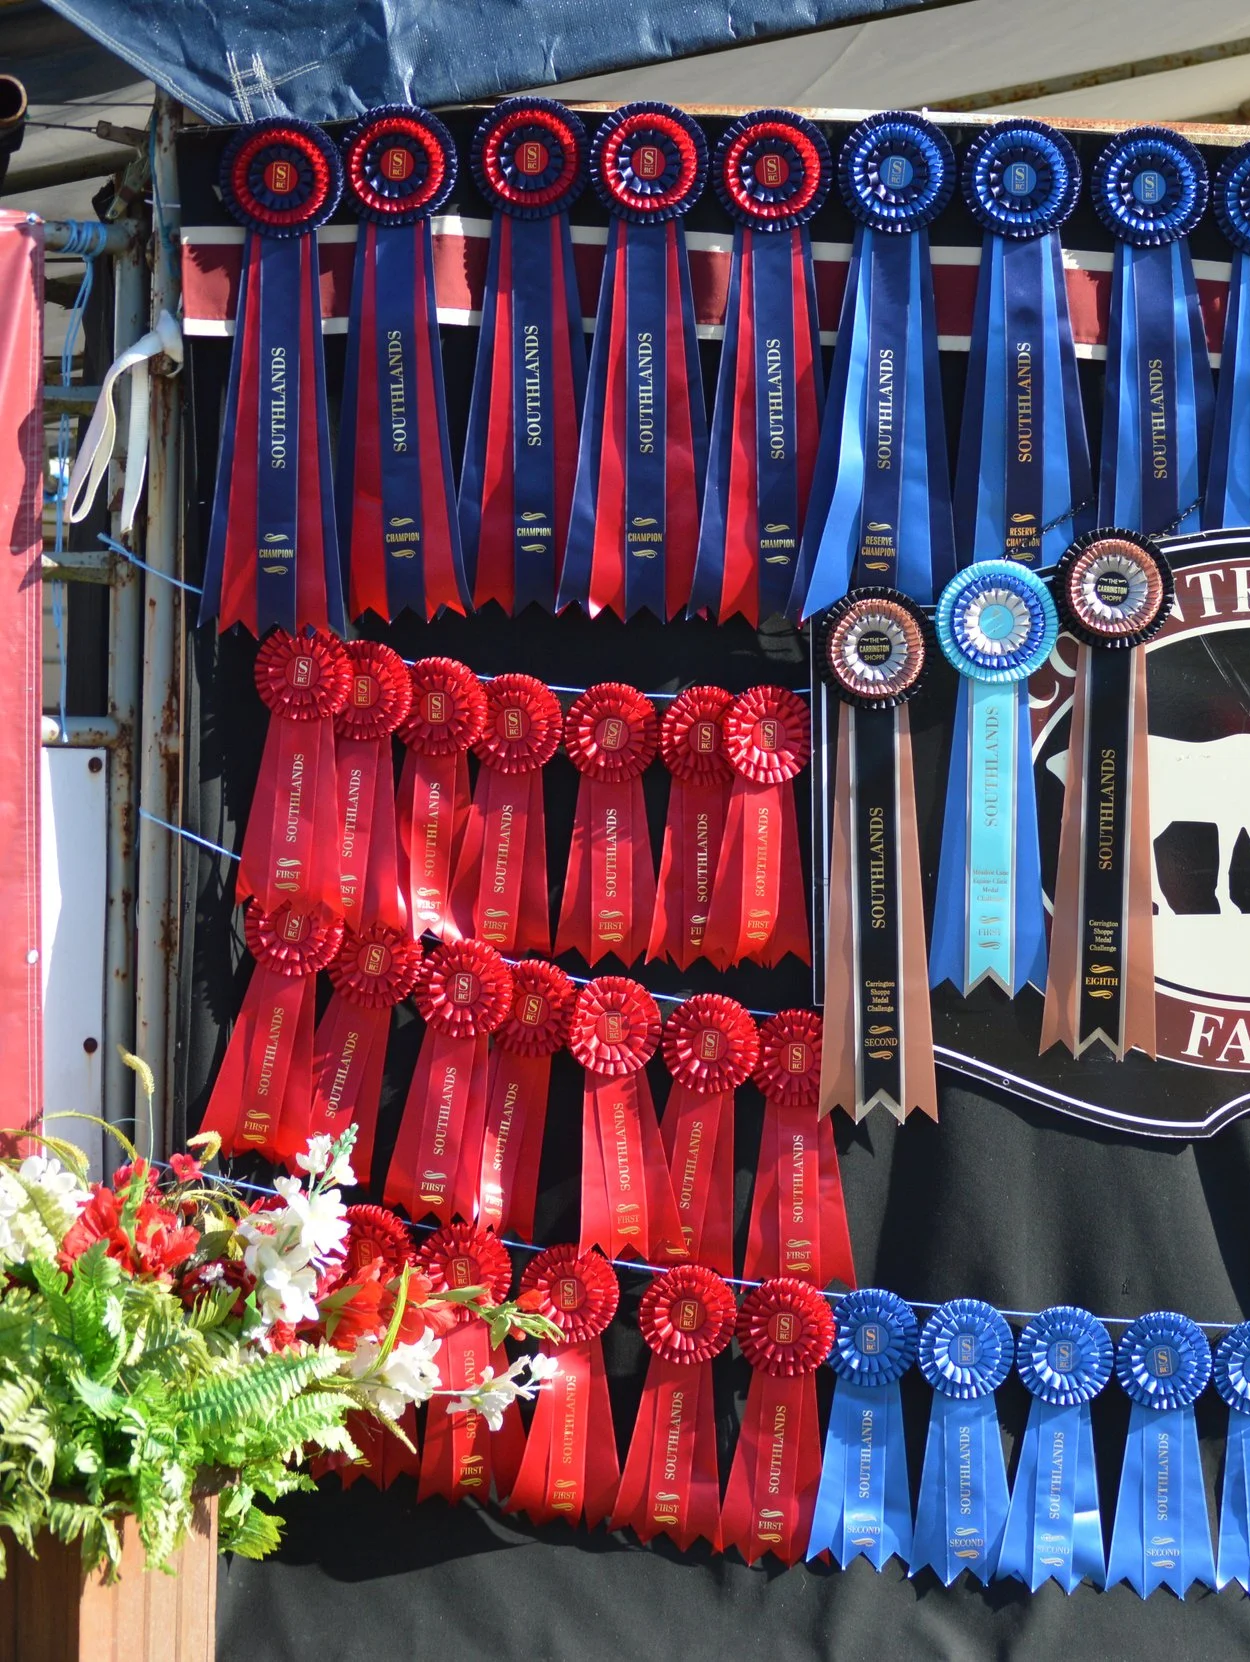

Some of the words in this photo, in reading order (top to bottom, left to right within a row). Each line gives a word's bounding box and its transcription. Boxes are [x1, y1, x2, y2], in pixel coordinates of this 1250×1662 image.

[271, 347, 286, 469] SOUTHLANDS
[387, 330, 406, 452] SOUTHLANDS
[525, 325, 541, 446] SOUTHLANDS
[638, 332, 652, 453] SOUTHLANDS
[766, 339, 784, 459] SOUTHLANDS
[877, 349, 894, 469] SOUTHLANDS
[1017, 342, 1031, 463] SOUTHLANDS
[1148, 358, 1167, 479] SOUTHLANDS
[259, 549, 293, 558] CHAMPION
[386, 532, 420, 542] CHAMPION
[516, 527, 551, 536] CHAMPION
[627, 532, 662, 542] CHAMPION
[760, 538, 795, 549] CHAMPION
[861, 546, 895, 556] CHAMPION
[865, 537, 892, 546] RESERVE
[1009, 527, 1036, 536] RESERVE
[286, 753, 305, 843] SOUTHLANDS
[984, 706, 999, 827] SOUTHLANDS
[1099, 749, 1115, 870] SOUTHLANDS
[342, 769, 362, 858] SOUTHLANDS
[423, 782, 440, 877] SOUTHLANDS
[494, 804, 513, 893] SOUTHLANDS
[606, 808, 616, 897] SOUTHLANDS
[755, 808, 768, 897] SOUTHLANDS
[276, 871, 300, 879] FIRST
[340, 886, 356, 894] RST
[697, 814, 708, 903] SOUTHLANDS
[872, 807, 884, 928] SOUTHLANDS
[417, 898, 441, 909] FIRST
[483, 921, 507, 930] FIRST
[599, 922, 624, 930] FIRST
[747, 920, 770, 929] FIRST
[1086, 977, 1118, 986] EIGHTH
[1090, 944, 1117, 953] Challenge
[258, 1006, 284, 1096] SOUTHLANDS
[326, 1031, 359, 1118] SOUTHLANDS
[865, 1038, 897, 1047] SECOND
[244, 1122, 270, 1134] FIRST
[432, 1067, 456, 1156] SOUTHLANDS
[493, 1082, 518, 1172] SOUTHLANDS
[613, 1103, 631, 1192] SOUTHLANDS
[421, 1183, 446, 1194] FIRST
[680, 1122, 702, 1209] SOUTHLANDS
[793, 1135, 804, 1223] SOUTHLANDS
[786, 1251, 812, 1260] FIRST
[562, 1375, 577, 1464] SOUTHLANDS
[665, 1392, 683, 1481] SOUTHLANDS
[769, 1405, 786, 1493] SOUTHLANDS
[859, 1409, 873, 1499] SOUTHLANDS
[460, 1466, 483, 1474] FIRST
[655, 1504, 678, 1514] FIRST
[960, 1426, 970, 1515] SOUTHLANDS
[1049, 1432, 1065, 1520] SOUTHLANDS
[1158, 1432, 1169, 1521] SOUTHLANDS
[758, 1521, 783, 1530] FIRST
[847, 1524, 880, 1534] SECOND
[950, 1538, 984, 1547] SECOND
[1146, 1548, 1180, 1557] SECOND
